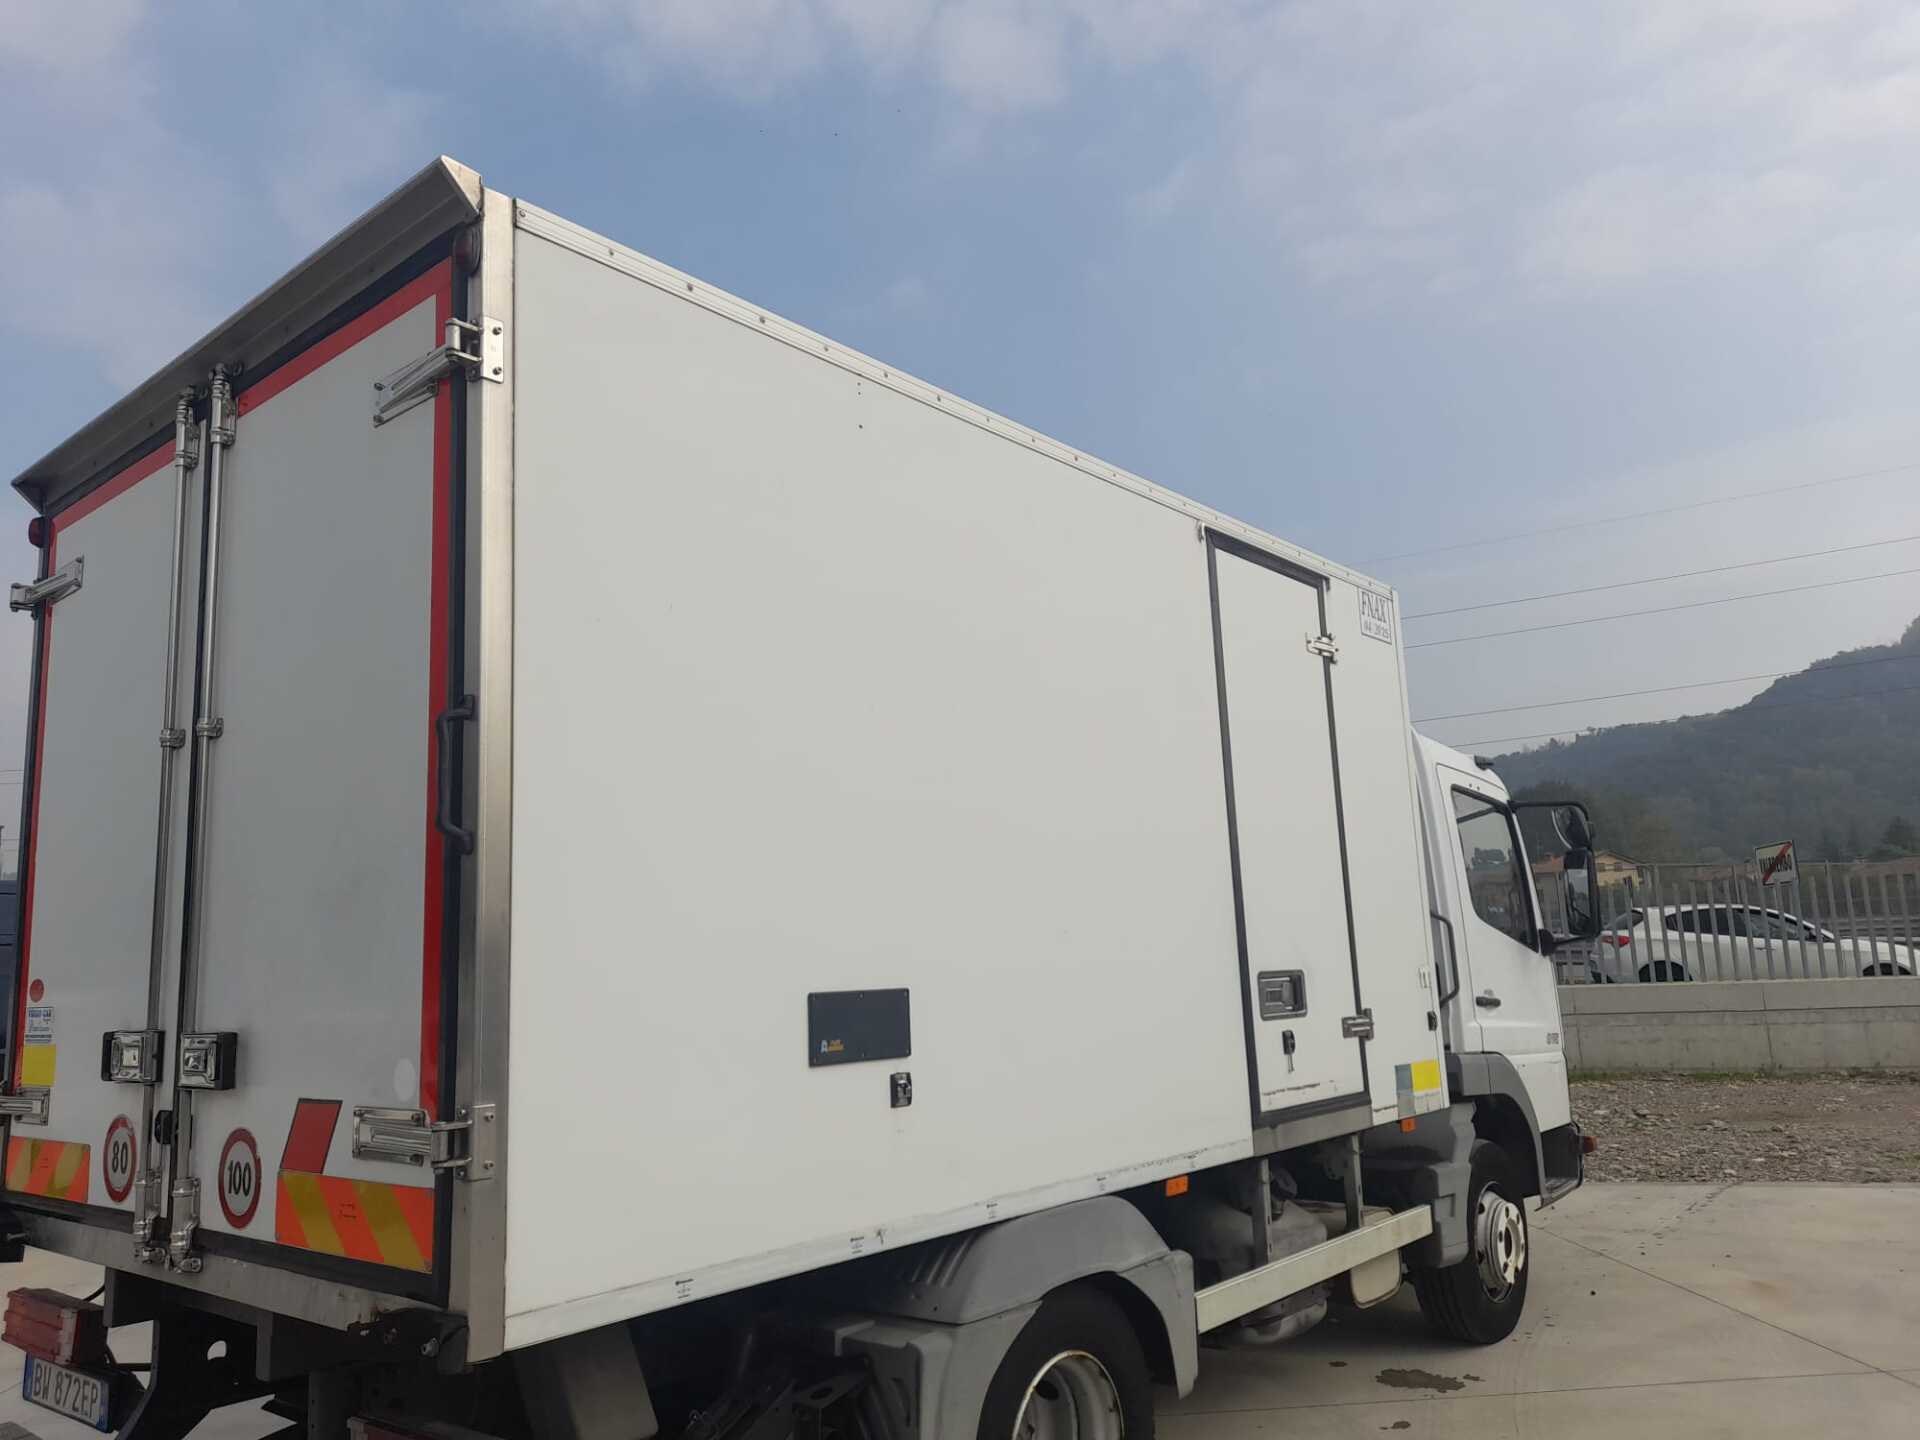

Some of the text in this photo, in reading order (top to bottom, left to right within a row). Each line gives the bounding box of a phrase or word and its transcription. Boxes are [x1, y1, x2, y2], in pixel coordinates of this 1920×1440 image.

[111, 1140, 129, 1175] 80
[227, 1159, 252, 1197] 100
[33, 1363, 98, 1419] BW 872EP
